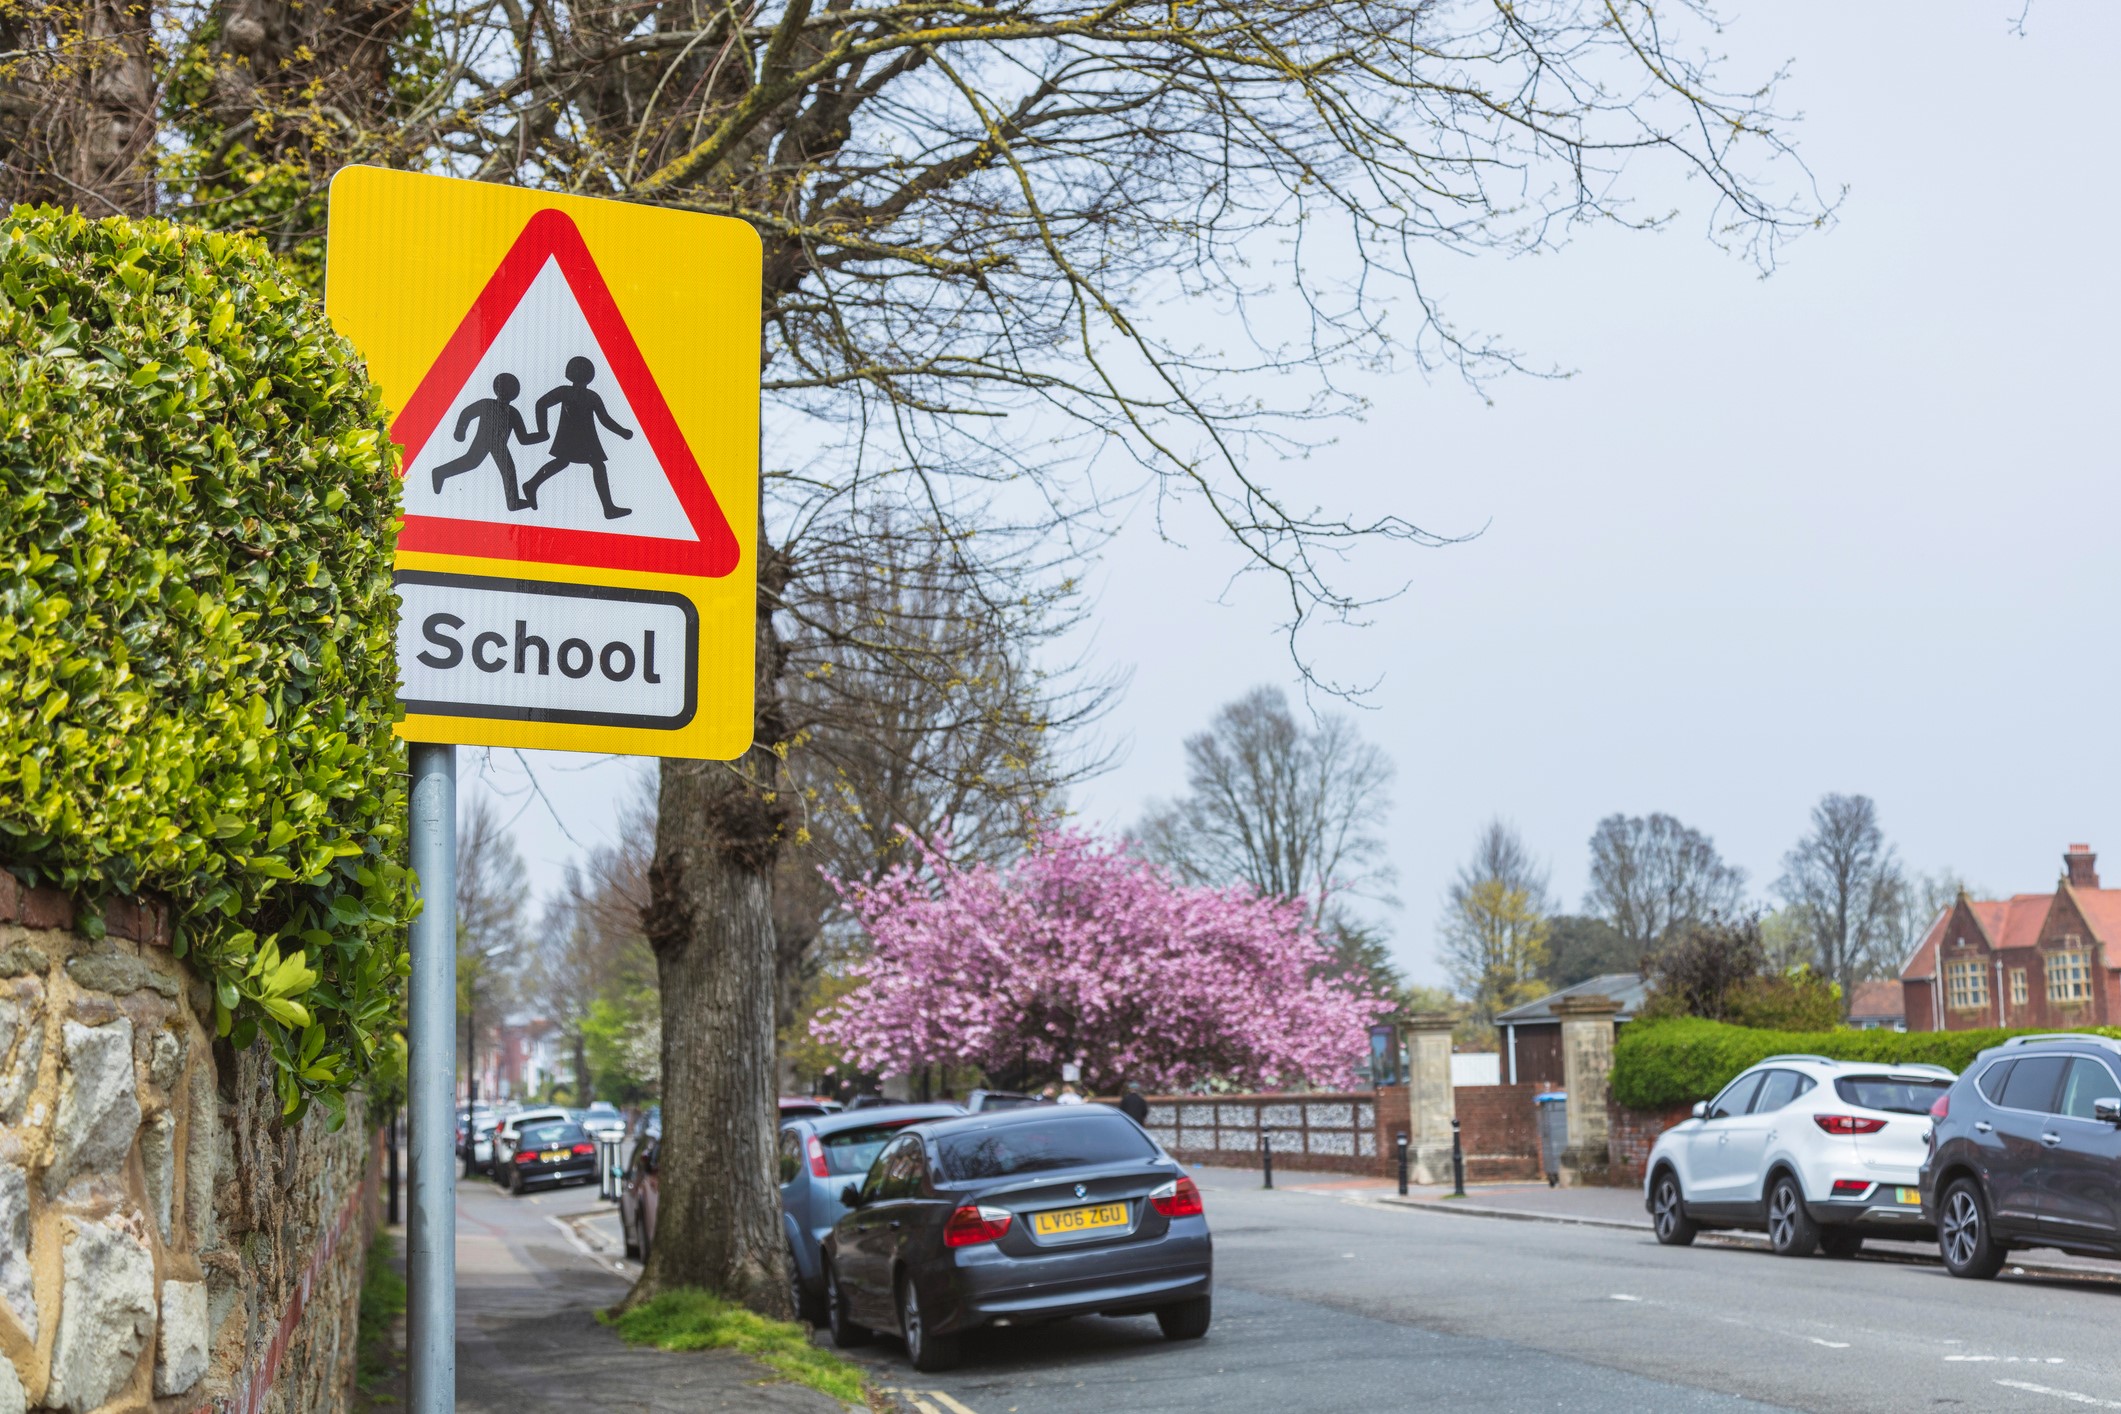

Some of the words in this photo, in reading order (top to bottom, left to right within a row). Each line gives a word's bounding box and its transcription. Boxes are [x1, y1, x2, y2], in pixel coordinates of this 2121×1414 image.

[416, 612, 661, 684] School
[1040, 1211, 1085, 1230] LV06
[1088, 1206, 1121, 1224] ZGU
